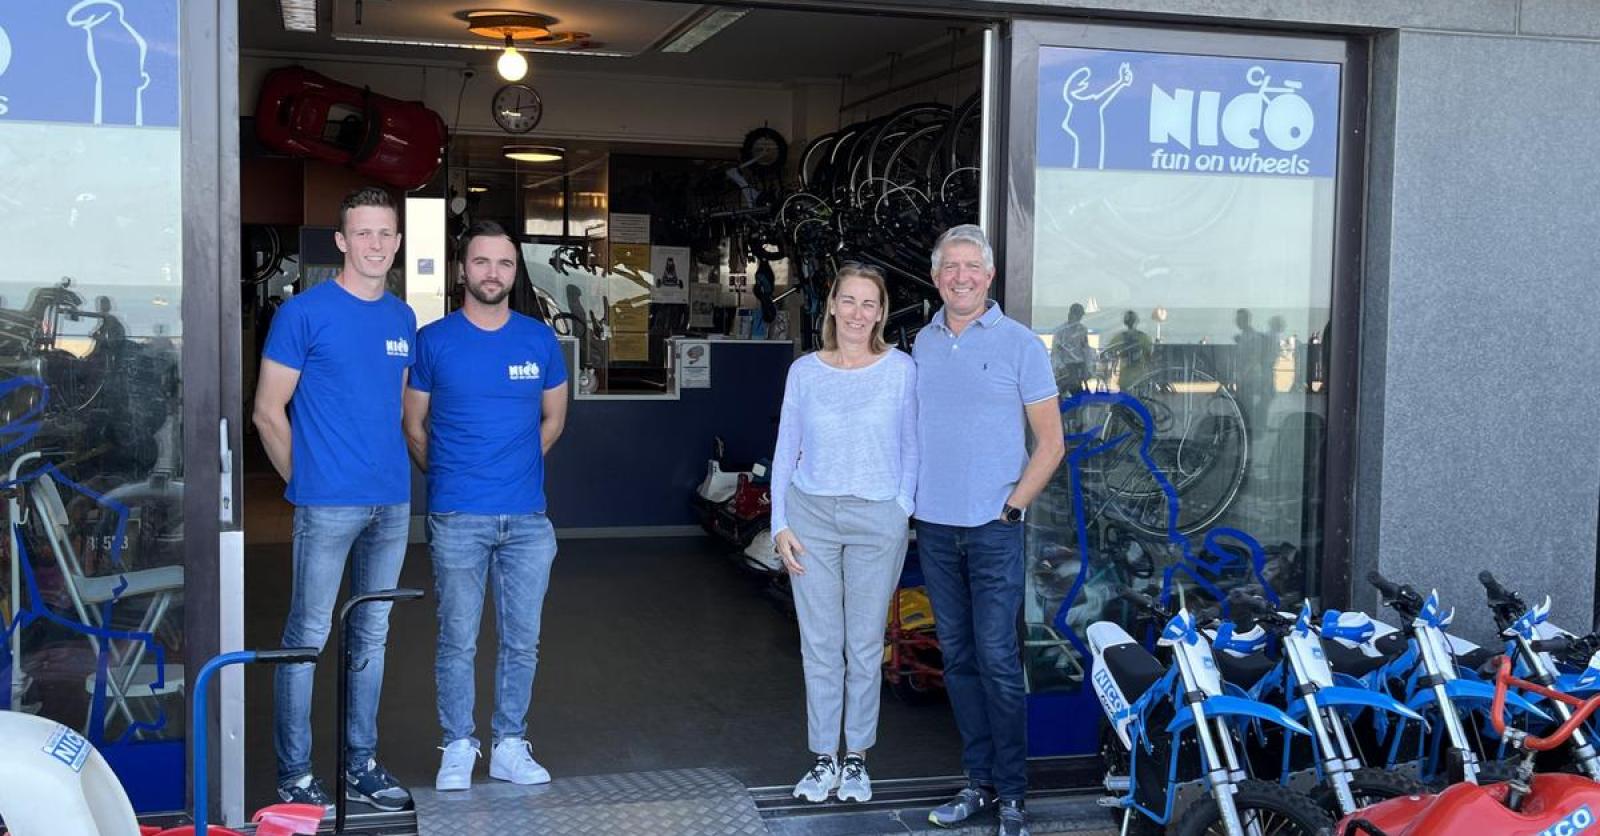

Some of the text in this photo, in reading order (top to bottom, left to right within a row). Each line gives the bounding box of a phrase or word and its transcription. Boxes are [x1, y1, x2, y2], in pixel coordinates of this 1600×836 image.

[1150, 82, 1314, 151] NICO
[1151, 148, 1311, 175] fun on wheels
[1094, 669, 1123, 713] NICO
[53, 732, 84, 764] NIC
